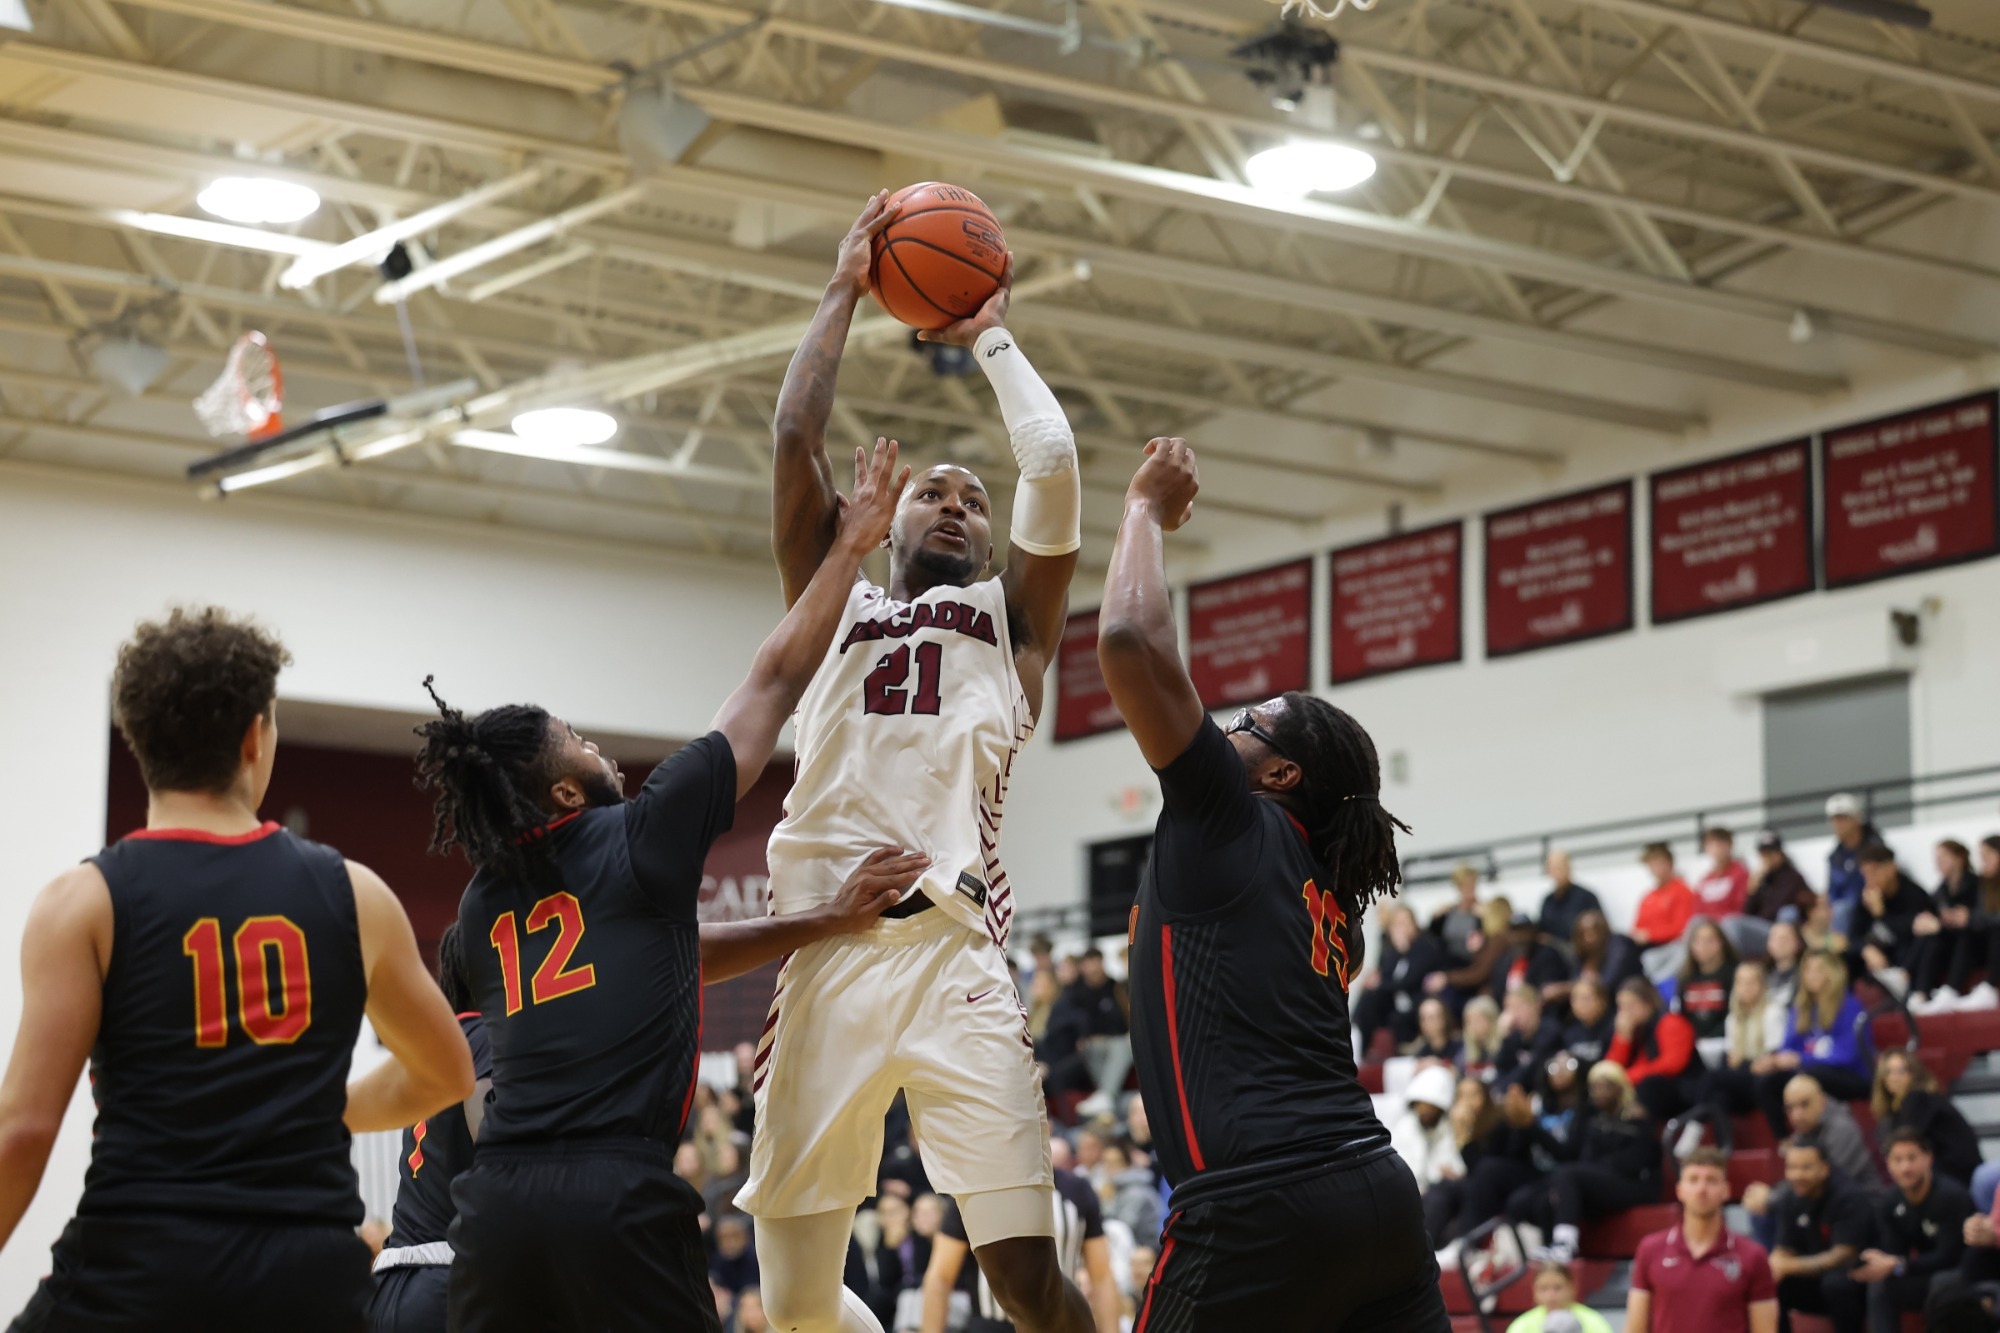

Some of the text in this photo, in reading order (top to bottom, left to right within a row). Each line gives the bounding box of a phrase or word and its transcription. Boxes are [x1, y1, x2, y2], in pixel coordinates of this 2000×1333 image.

[864, 640, 942, 715] 21
[183, 914, 311, 1047] 10
[490, 891, 596, 1017] 12
